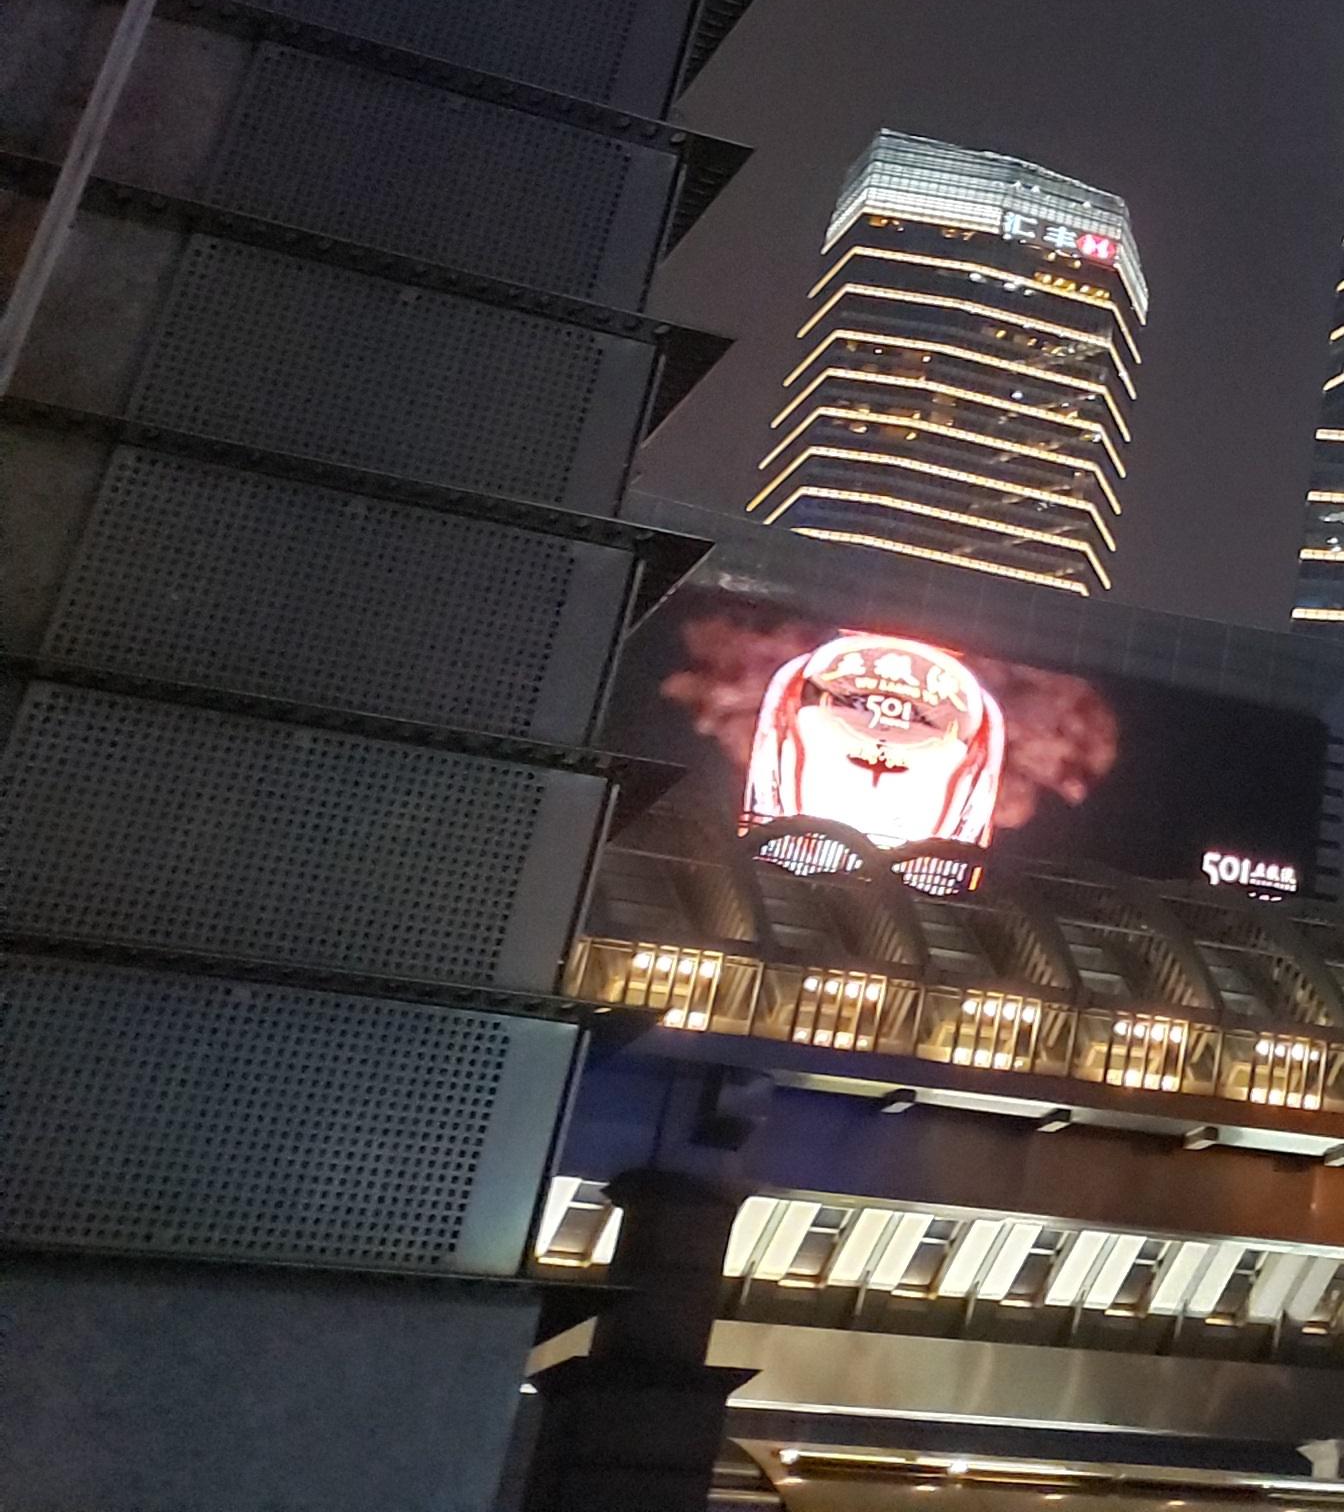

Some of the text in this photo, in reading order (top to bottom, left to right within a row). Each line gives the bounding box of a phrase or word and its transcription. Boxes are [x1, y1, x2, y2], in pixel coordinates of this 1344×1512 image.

[1002, 211, 1077, 248] 汇丰
[866, 694, 912, 729] 501
[1202, 851, 1251, 886] 501
